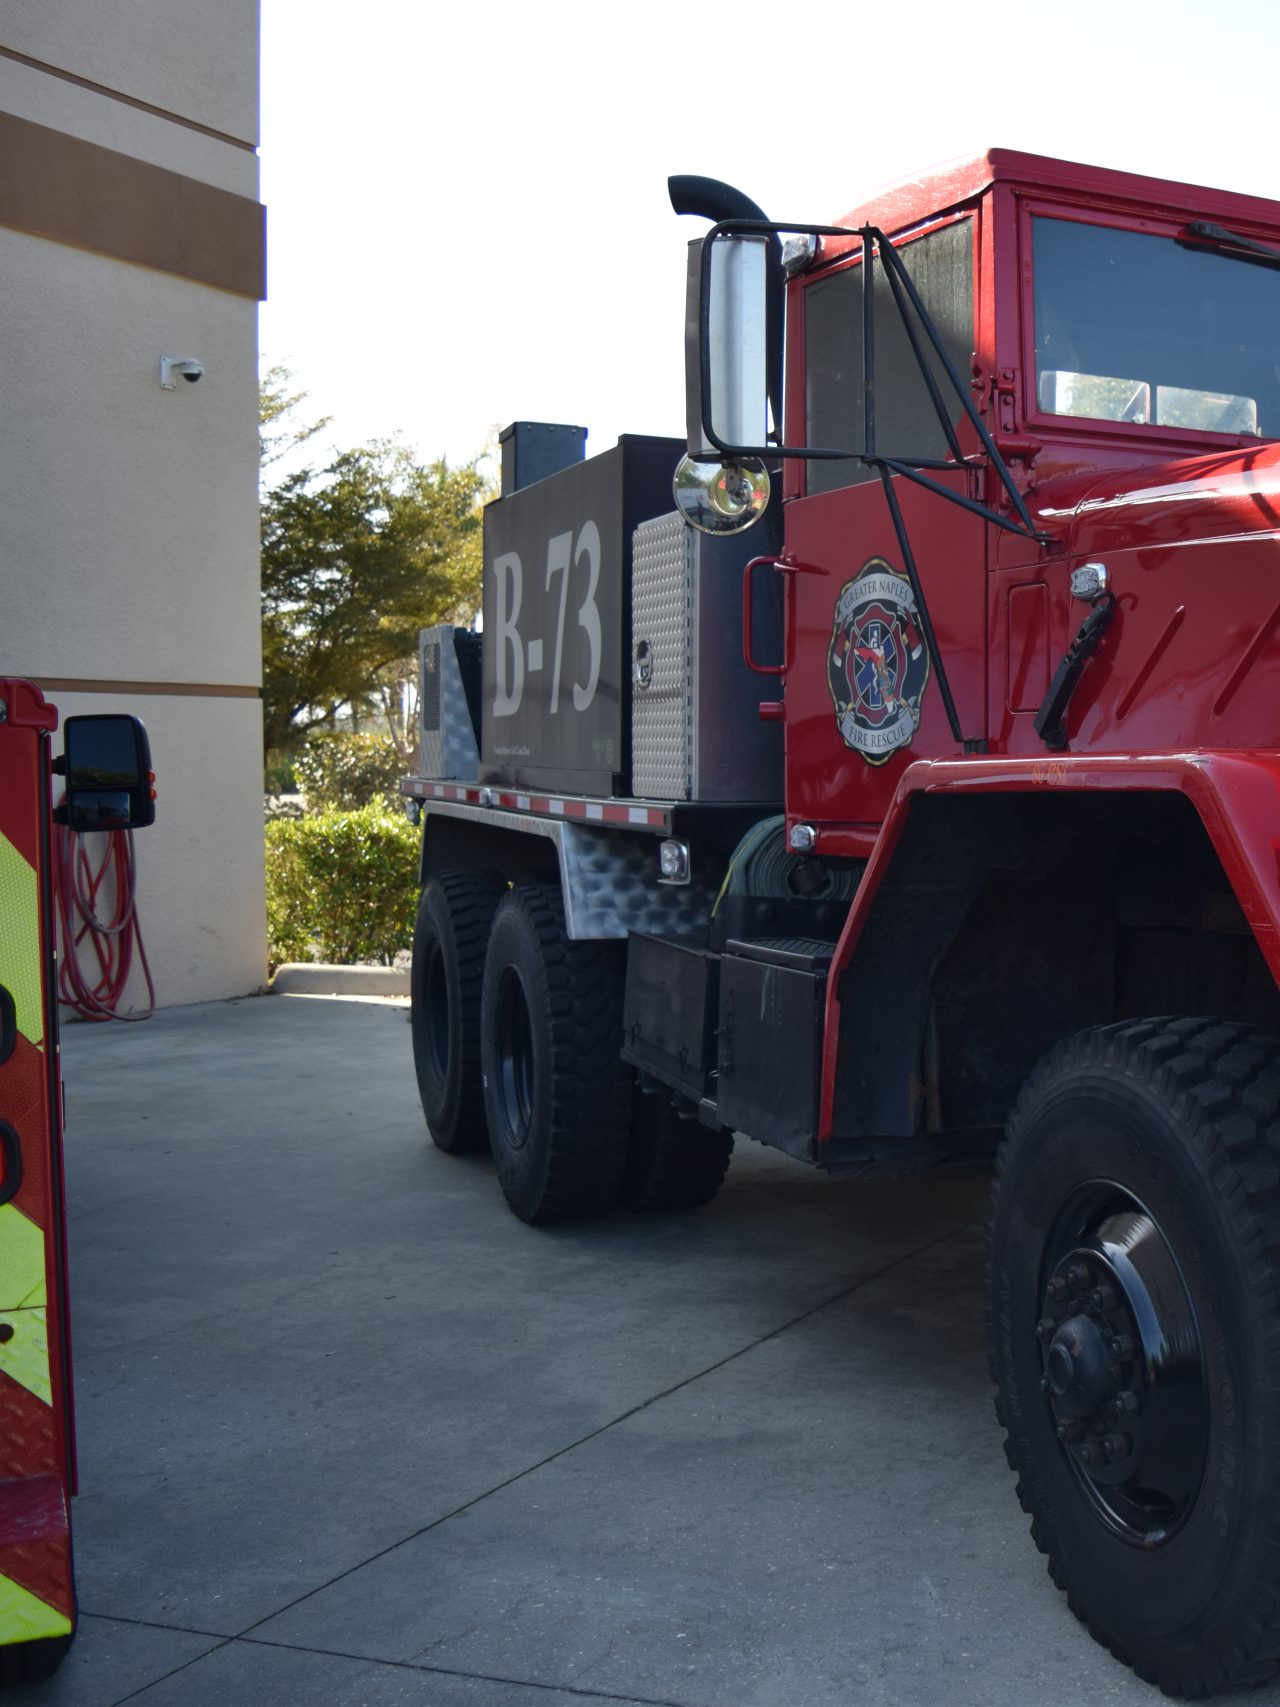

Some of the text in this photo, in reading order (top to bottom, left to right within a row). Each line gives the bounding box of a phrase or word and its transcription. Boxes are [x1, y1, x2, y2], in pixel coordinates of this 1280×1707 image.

[844, 579, 908, 609] GREATER NAPLES
[493, 520, 601, 717] B-73
[849, 723, 906, 748] FIRE RESCUE
